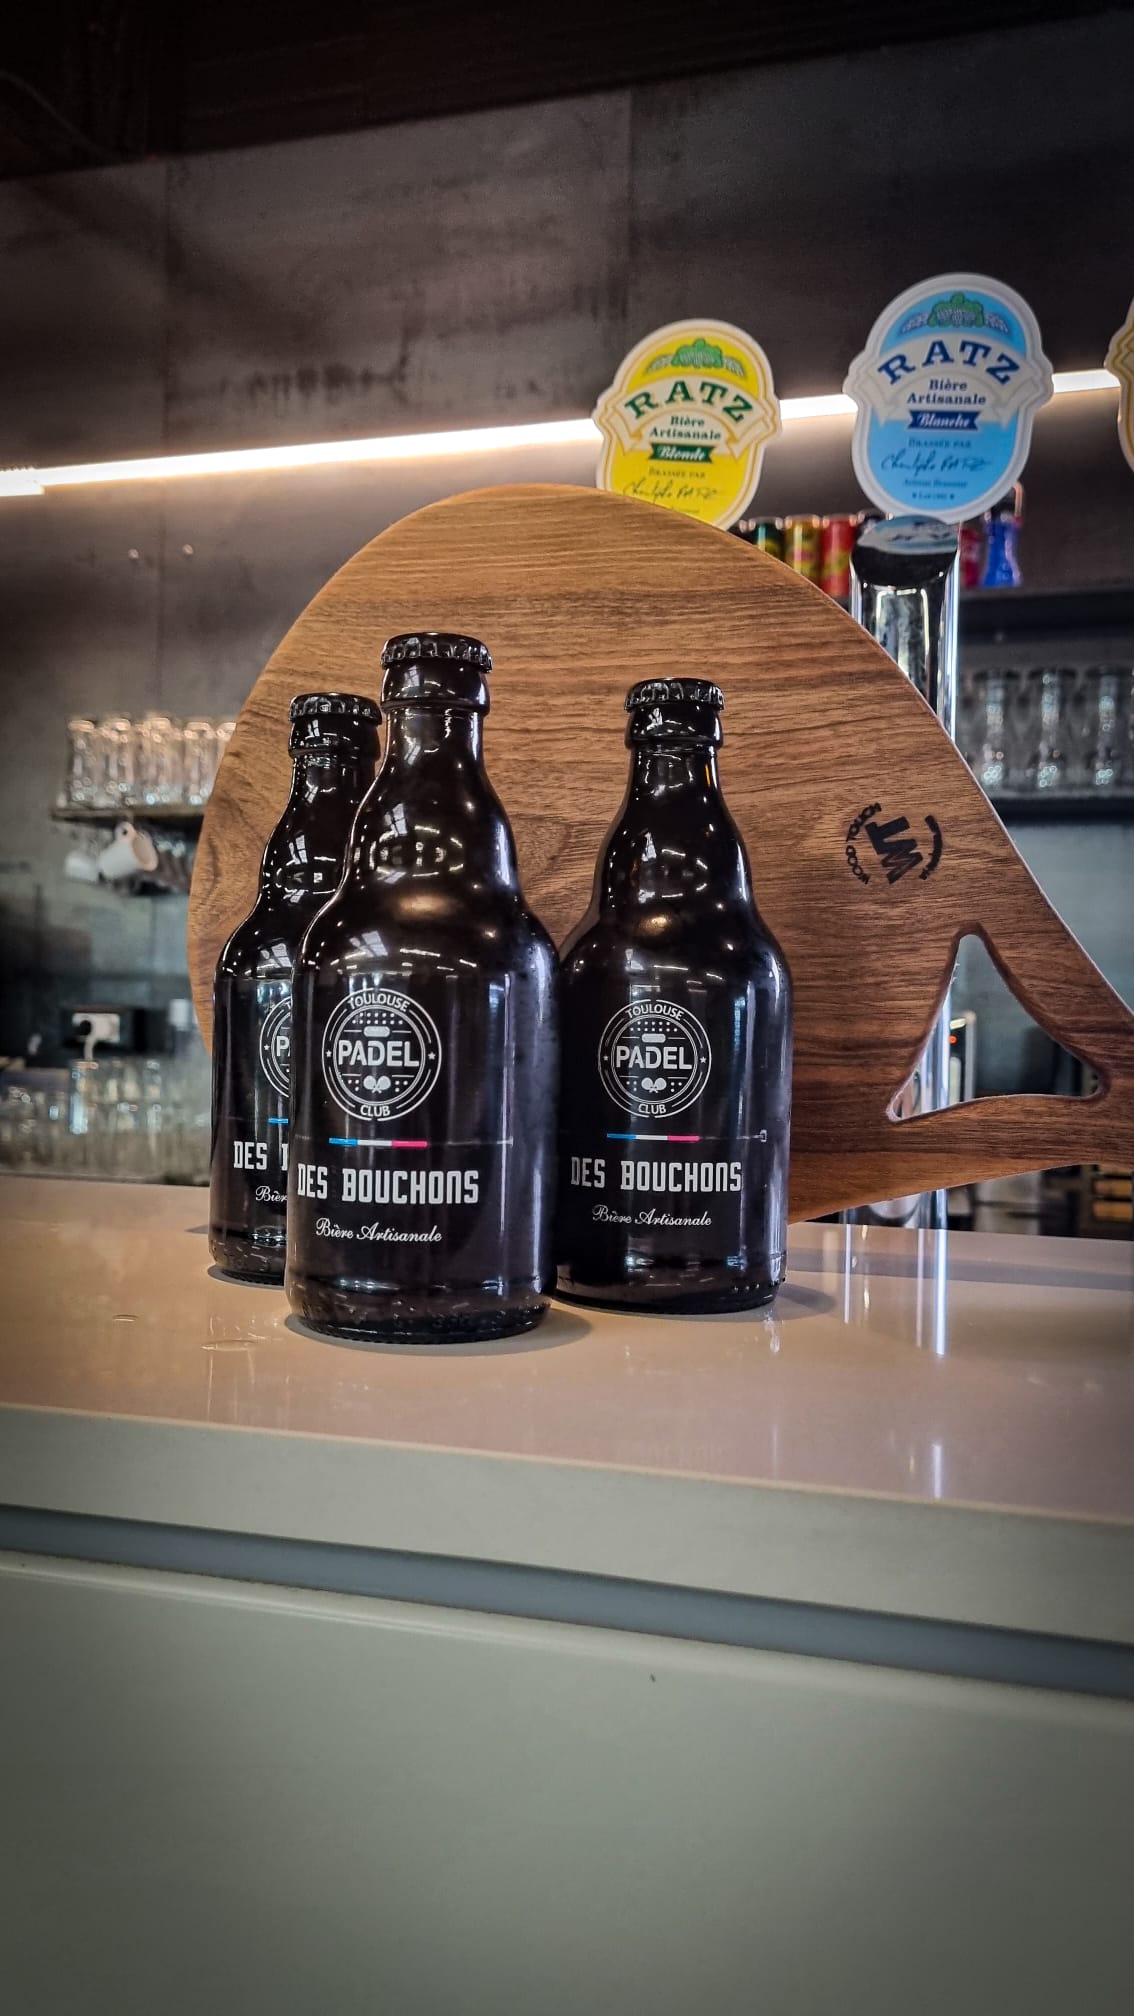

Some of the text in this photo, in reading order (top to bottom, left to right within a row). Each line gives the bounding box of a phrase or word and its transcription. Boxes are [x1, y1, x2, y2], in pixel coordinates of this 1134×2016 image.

[878, 340, 1020, 386] RATZ
[929, 379, 967, 391] Bière
[624, 380, 753, 423] RATZ
[907, 392, 986, 405] Artisanale
[670, 415, 705, 426] Bière
[918, 411, 971, 429] Blanche
[650, 427, 721, 440] Artisanale
[658, 445, 707, 461] Blonde
[347, 993, 411, 1012] TOULOUSE
[625, 1003, 685, 1021] TOULOUSE
[338, 1039, 420, 1067] PADEL
[616, 1045, 693, 1070] PADEL
[360, 1104, 391, 1117] CLUB
[638, 1103, 667, 1115] CLUB
[234, 1140, 268, 1171] DES
[297, 1162, 479, 1204] DES BOUCHONS
[570, 1156, 742, 1192] DES BOUCHONS
[255, 1185, 288, 1202] Bièr
[592, 1204, 712, 1226] Bière Artisanale
[315, 1217, 442, 1242] Bière Artisanale
